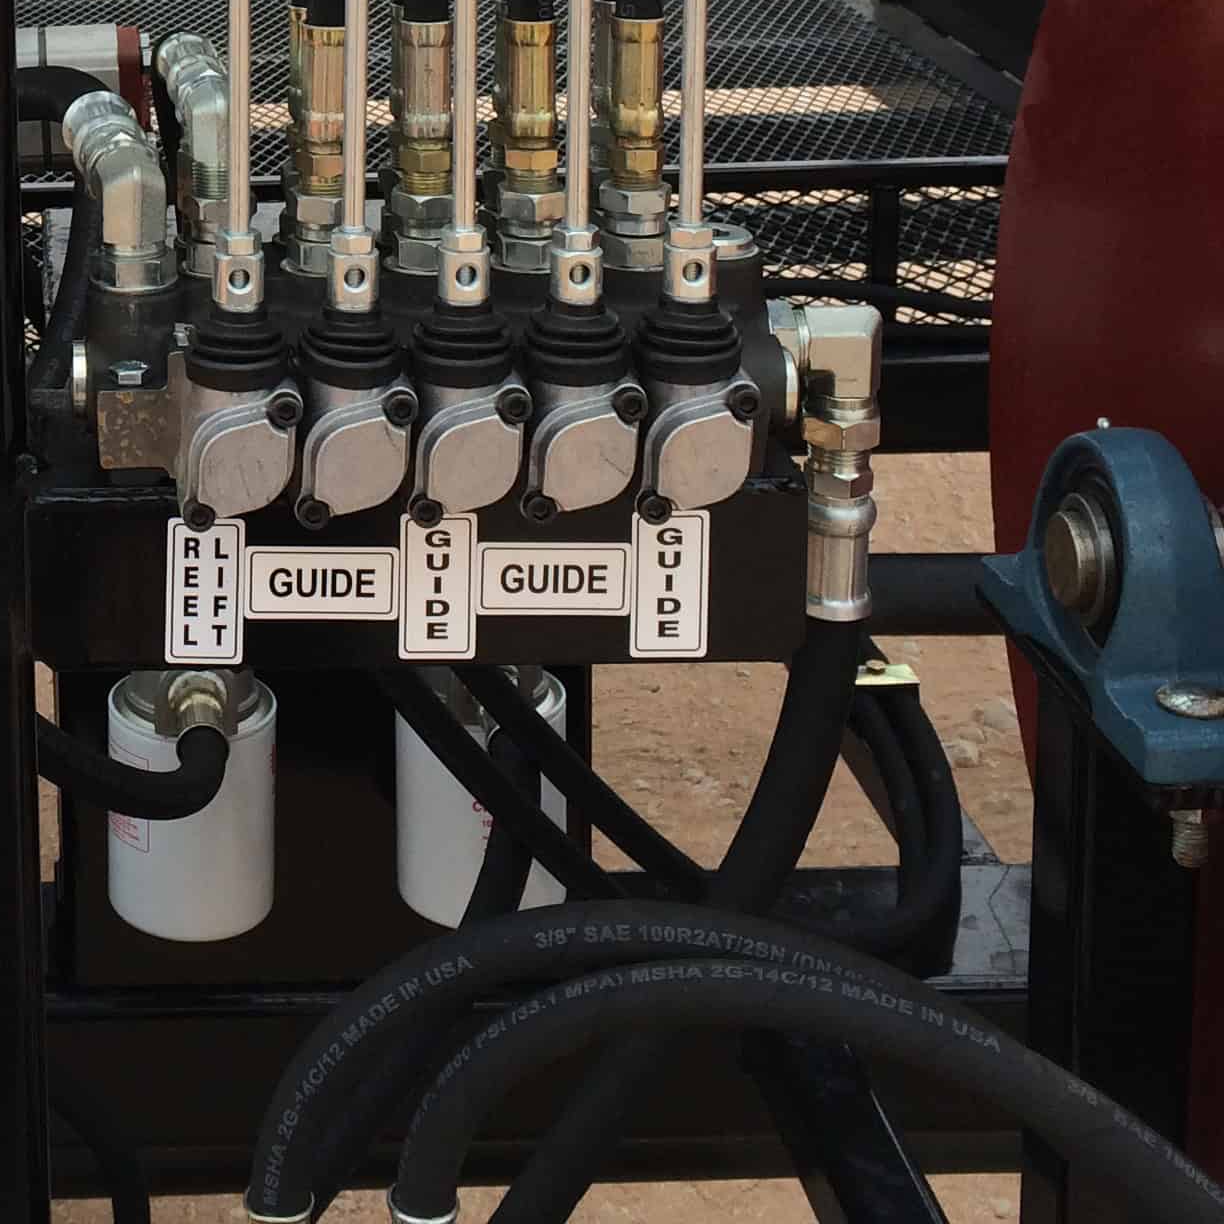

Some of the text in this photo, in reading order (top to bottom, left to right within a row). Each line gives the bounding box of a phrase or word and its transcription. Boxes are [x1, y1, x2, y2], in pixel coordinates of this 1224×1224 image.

[182, 537, 200, 648] REEL
[212, 537, 229, 648] LIFT
[268, 566, 376, 599] GUIDE
[424, 530, 452, 641] GUIDE
[500, 563, 609, 595] GUIDE
[656, 527, 684, 639] GUIDE
[582, 923, 632, 944] SAE
[340, 993, 401, 1047] MADE
[398, 977, 422, 1001] IN
[424, 955, 473, 986] USA
[631, 966, 704, 984] MSHA
[840, 982, 914, 1015] MADE
[920, 1005, 945, 1027] IN
[952, 1017, 1001, 1055] USA
